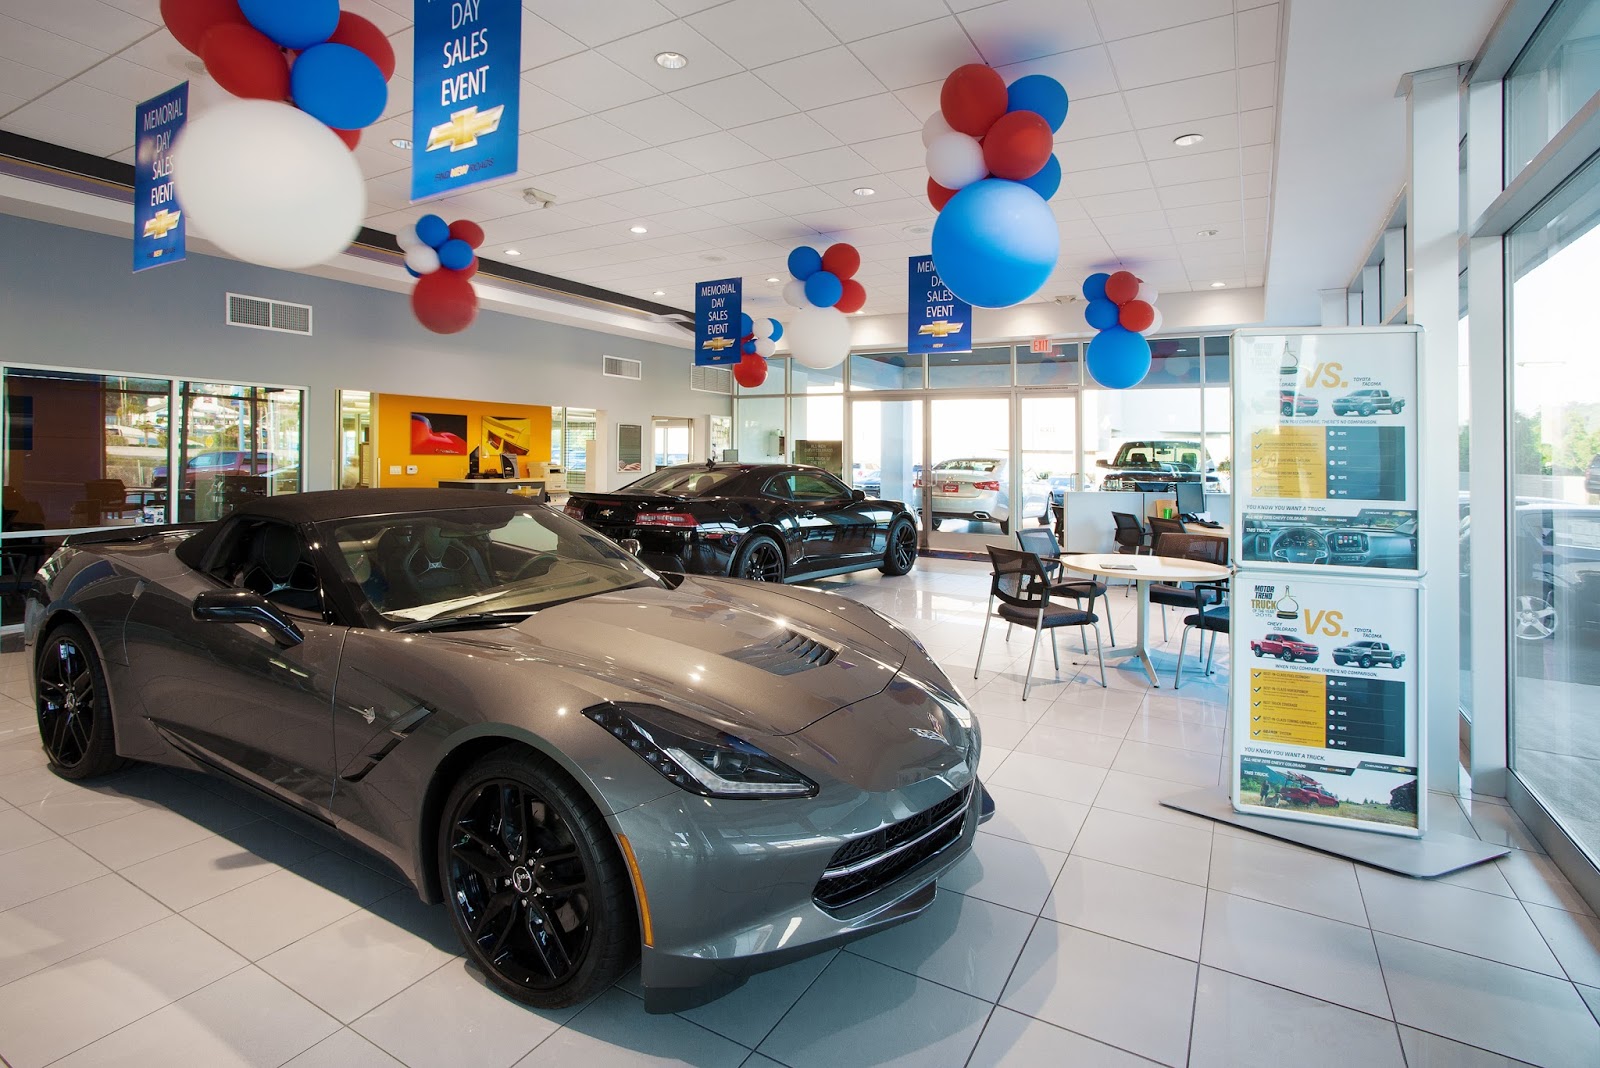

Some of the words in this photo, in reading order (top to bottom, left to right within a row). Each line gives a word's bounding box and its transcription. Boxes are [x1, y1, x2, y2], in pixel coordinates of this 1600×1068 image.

[451, 0, 480, 29] DAY
[443, 28, 488, 68] SALES
[441, 65, 490, 106] EVENT
[143, 97, 183, 132] MEMORIAL
[156, 129, 172, 154] DAY
[152, 154, 174, 181] SALES
[151, 181, 175, 207] EVENT
[931, 275, 945, 287] DA
[701, 284, 736, 297] MEMORIAL
[927, 290, 954, 303] SALES
[711, 298, 725, 309] DAY
[708, 310, 729, 321] SALES
[926, 305, 954, 318] EVENT
[707, 323, 729, 335] EVENT
[1033, 339, 1049, 352] EXIT
[1254, 585, 1275, 593] MOTOR
[1255, 592, 1273, 600] TREND
[1251, 599, 1277, 610] TRUCK
[1304, 609, 1349, 638] VS.
